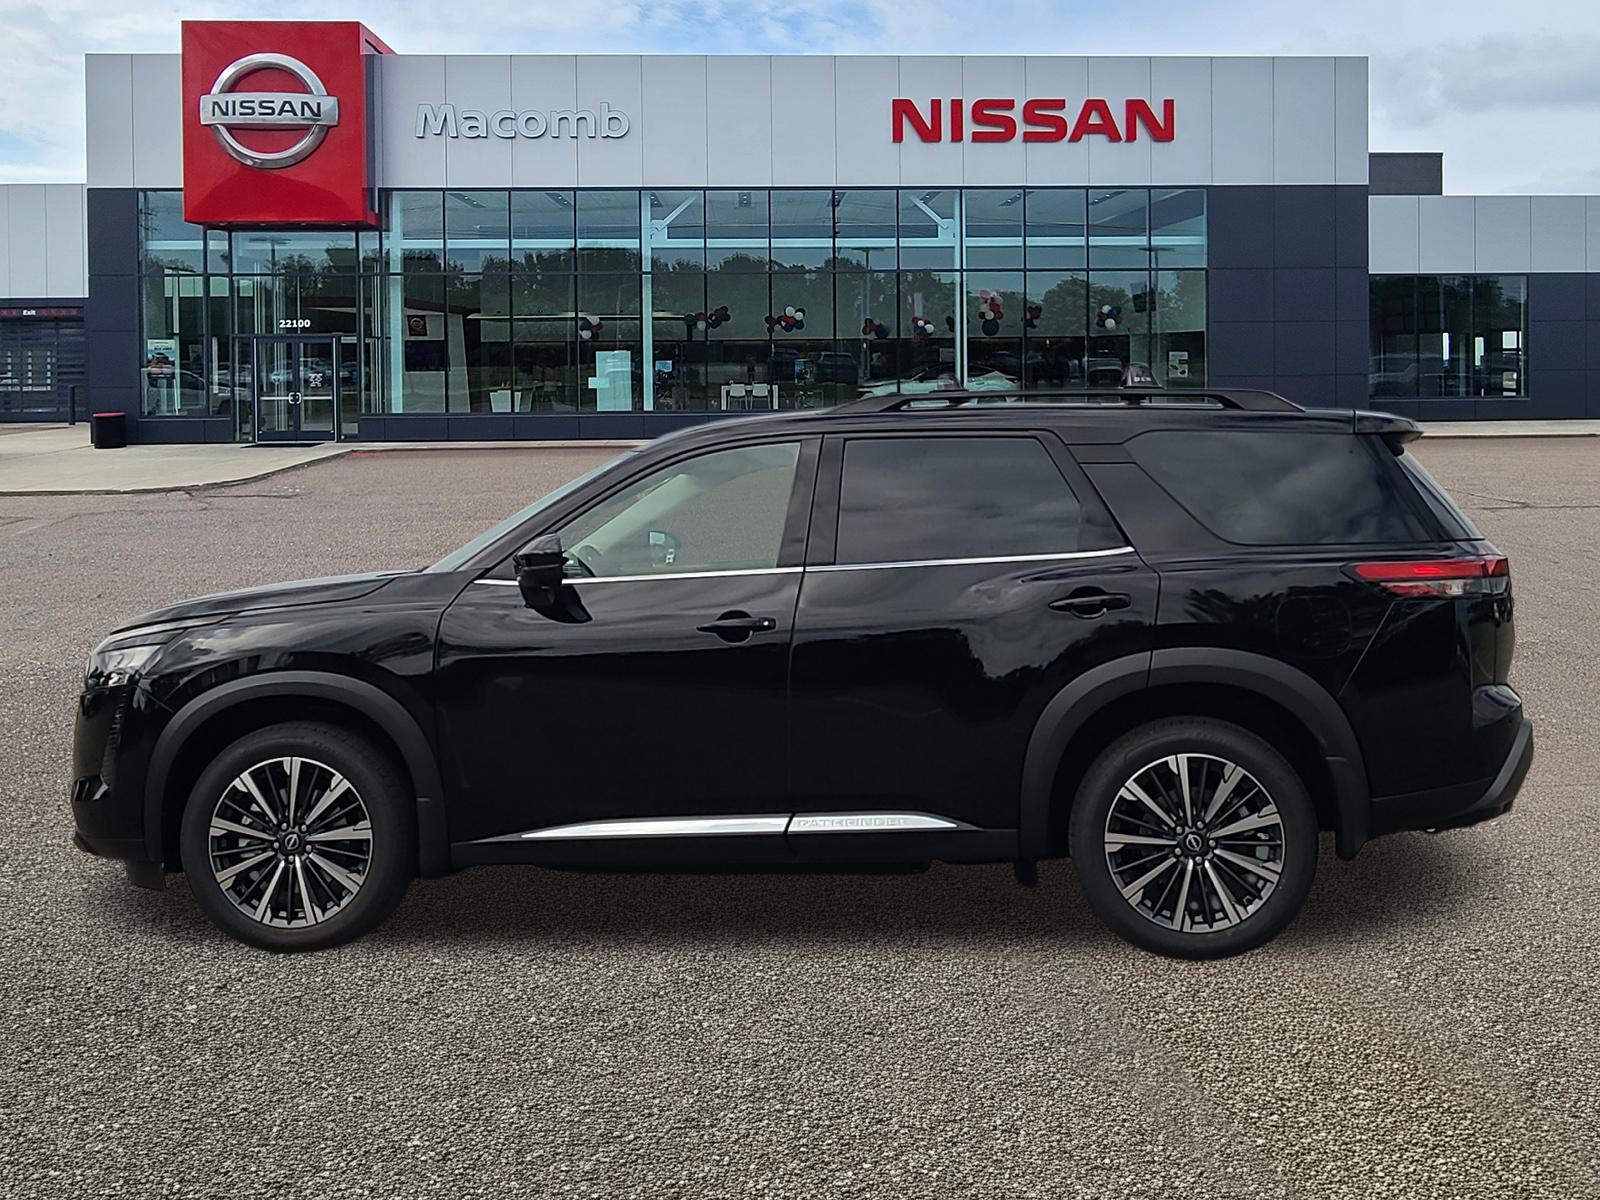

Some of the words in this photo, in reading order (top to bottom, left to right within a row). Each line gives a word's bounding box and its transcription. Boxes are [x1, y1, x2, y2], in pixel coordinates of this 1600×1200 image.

[211, 100, 322, 118] NISSAN
[415, 103, 630, 140] Macomb
[892, 98, 1176, 143] NISSAN
[279, 319, 311, 328] 22100
